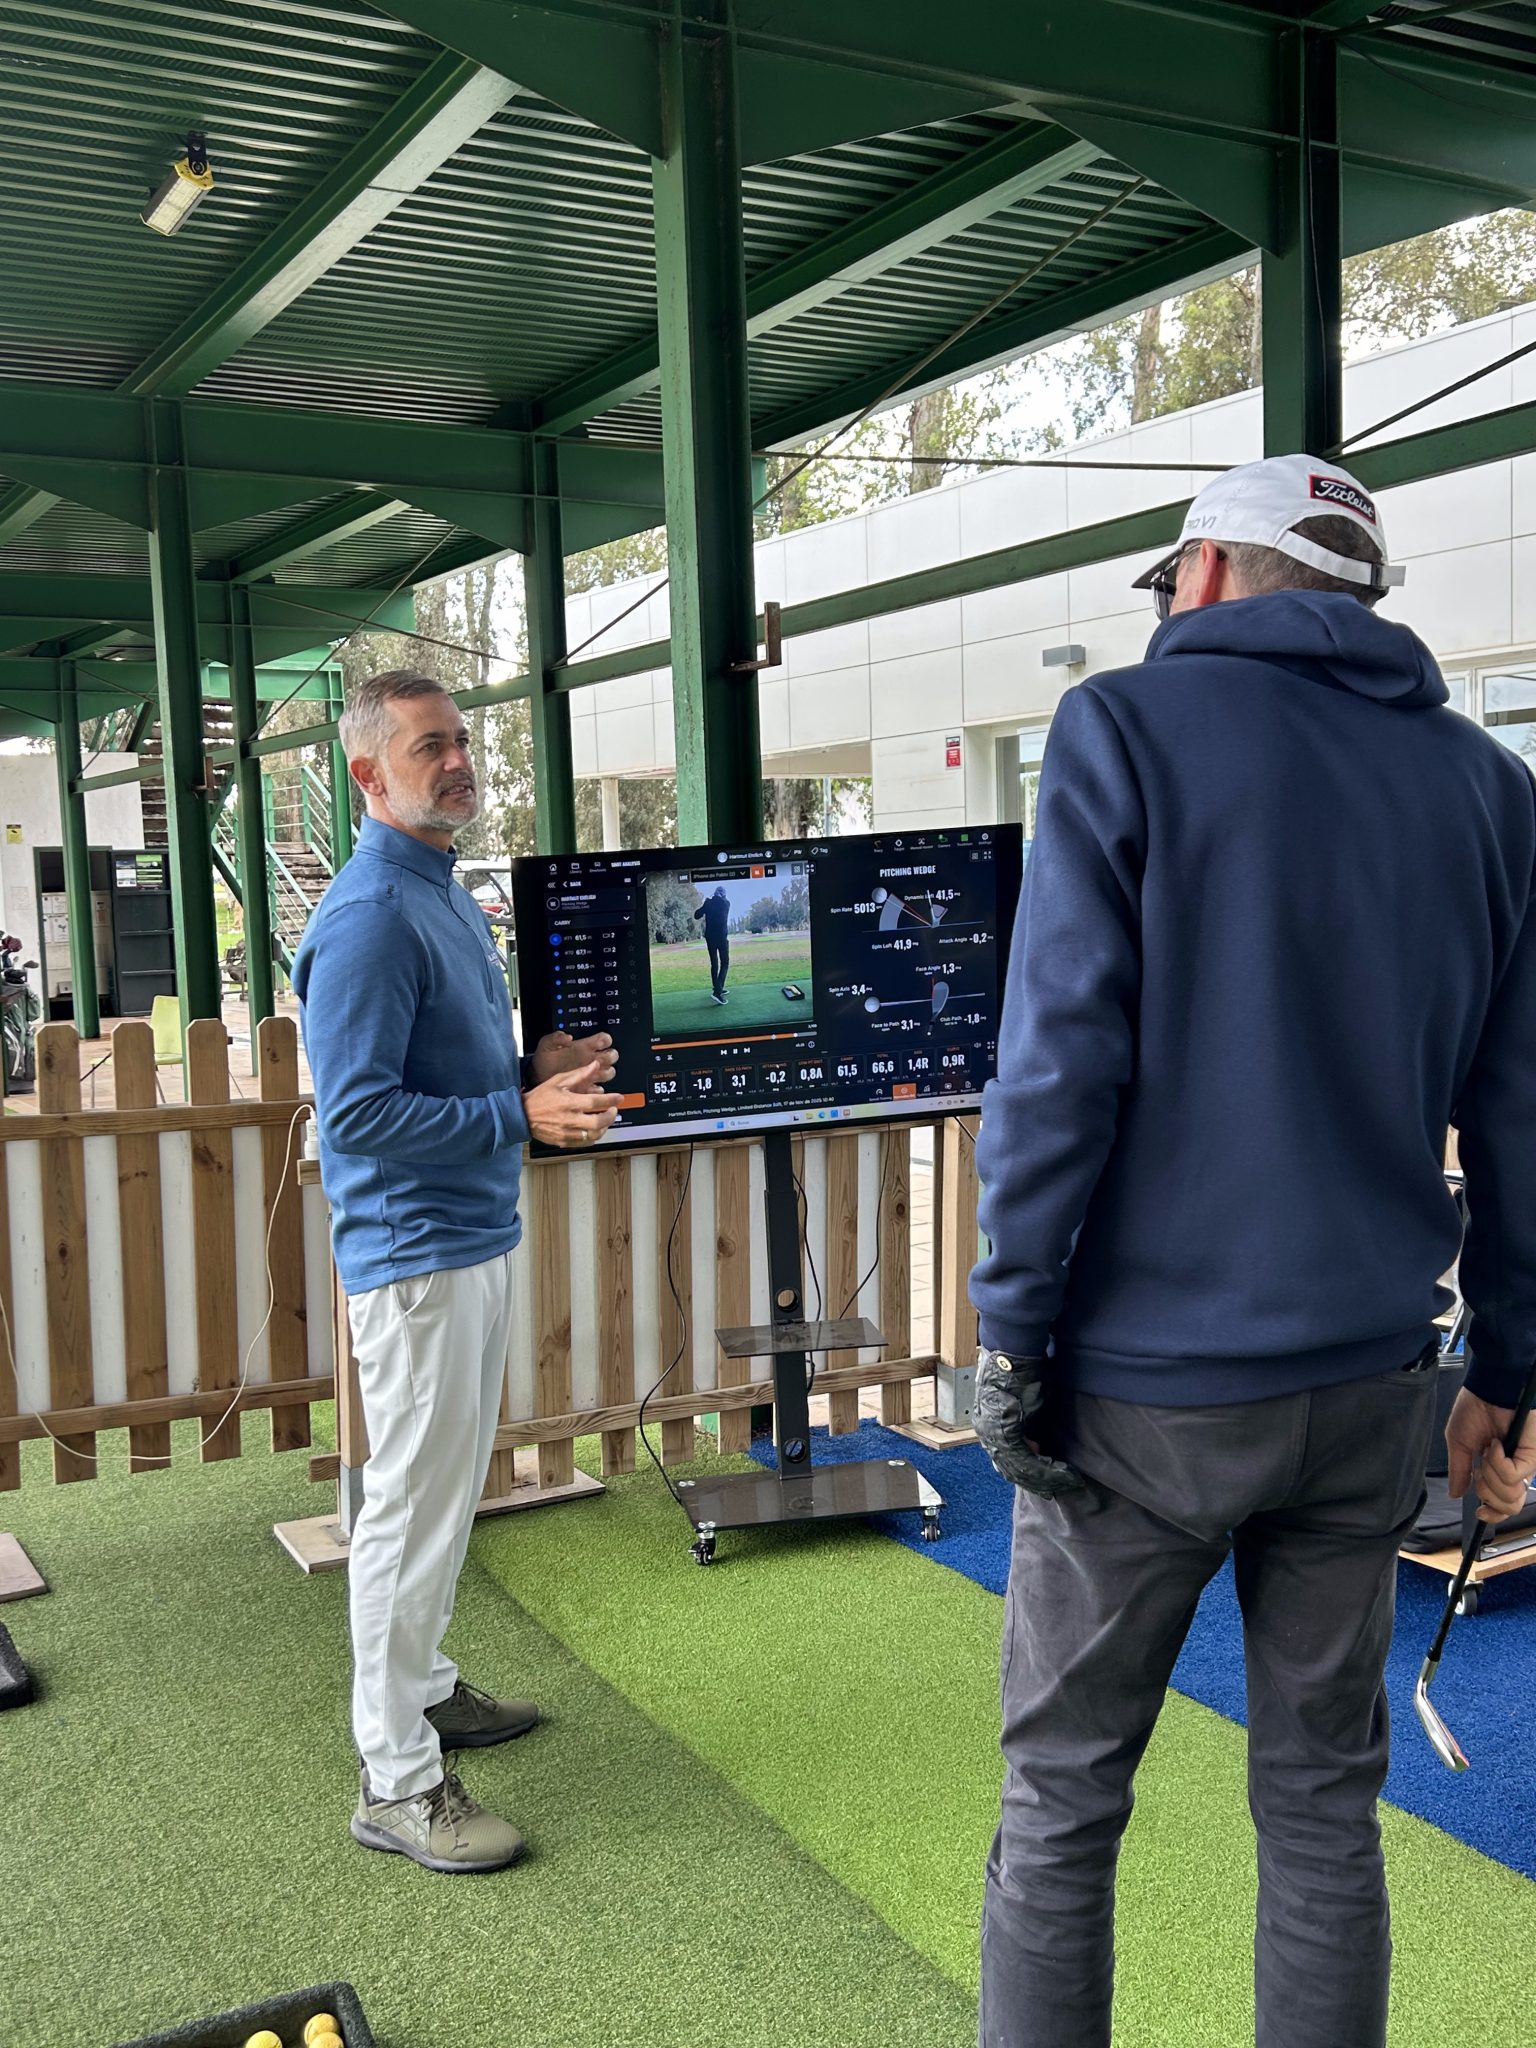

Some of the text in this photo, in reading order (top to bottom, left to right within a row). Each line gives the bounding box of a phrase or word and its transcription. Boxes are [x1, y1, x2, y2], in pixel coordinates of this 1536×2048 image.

[1315, 480, 1375, 518] Titleist
[879, 865, 936, 877] PITCHING WEDGE
[935, 889, 954, 901] 41,5
[854, 902, 876, 914] 5013
[968, 933, 987, 944] -0,2
[893, 939, 912, 951] 41,9
[942, 963, 955, 974] 1,3
[851, 984, 866, 995] 3,4
[901, 1019, 913, 1030] 3,1
[963, 1013, 980, 1025] -1,8
[907, 1057, 929, 1071] 1,4R
[942, 1054, 965, 1068] 0,9R
[837, 1064, 858, 1078] 61,5
[872, 1061, 894, 1074] 66,6
[765, 1071, 786, 1084] -0,2
[800, 1067, 823, 1081] 0,8A
[693, 1078, 712, 1091] -1,8
[731, 1075, 746, 1087] 3,1
[654, 1081, 677, 1094] 55,2
